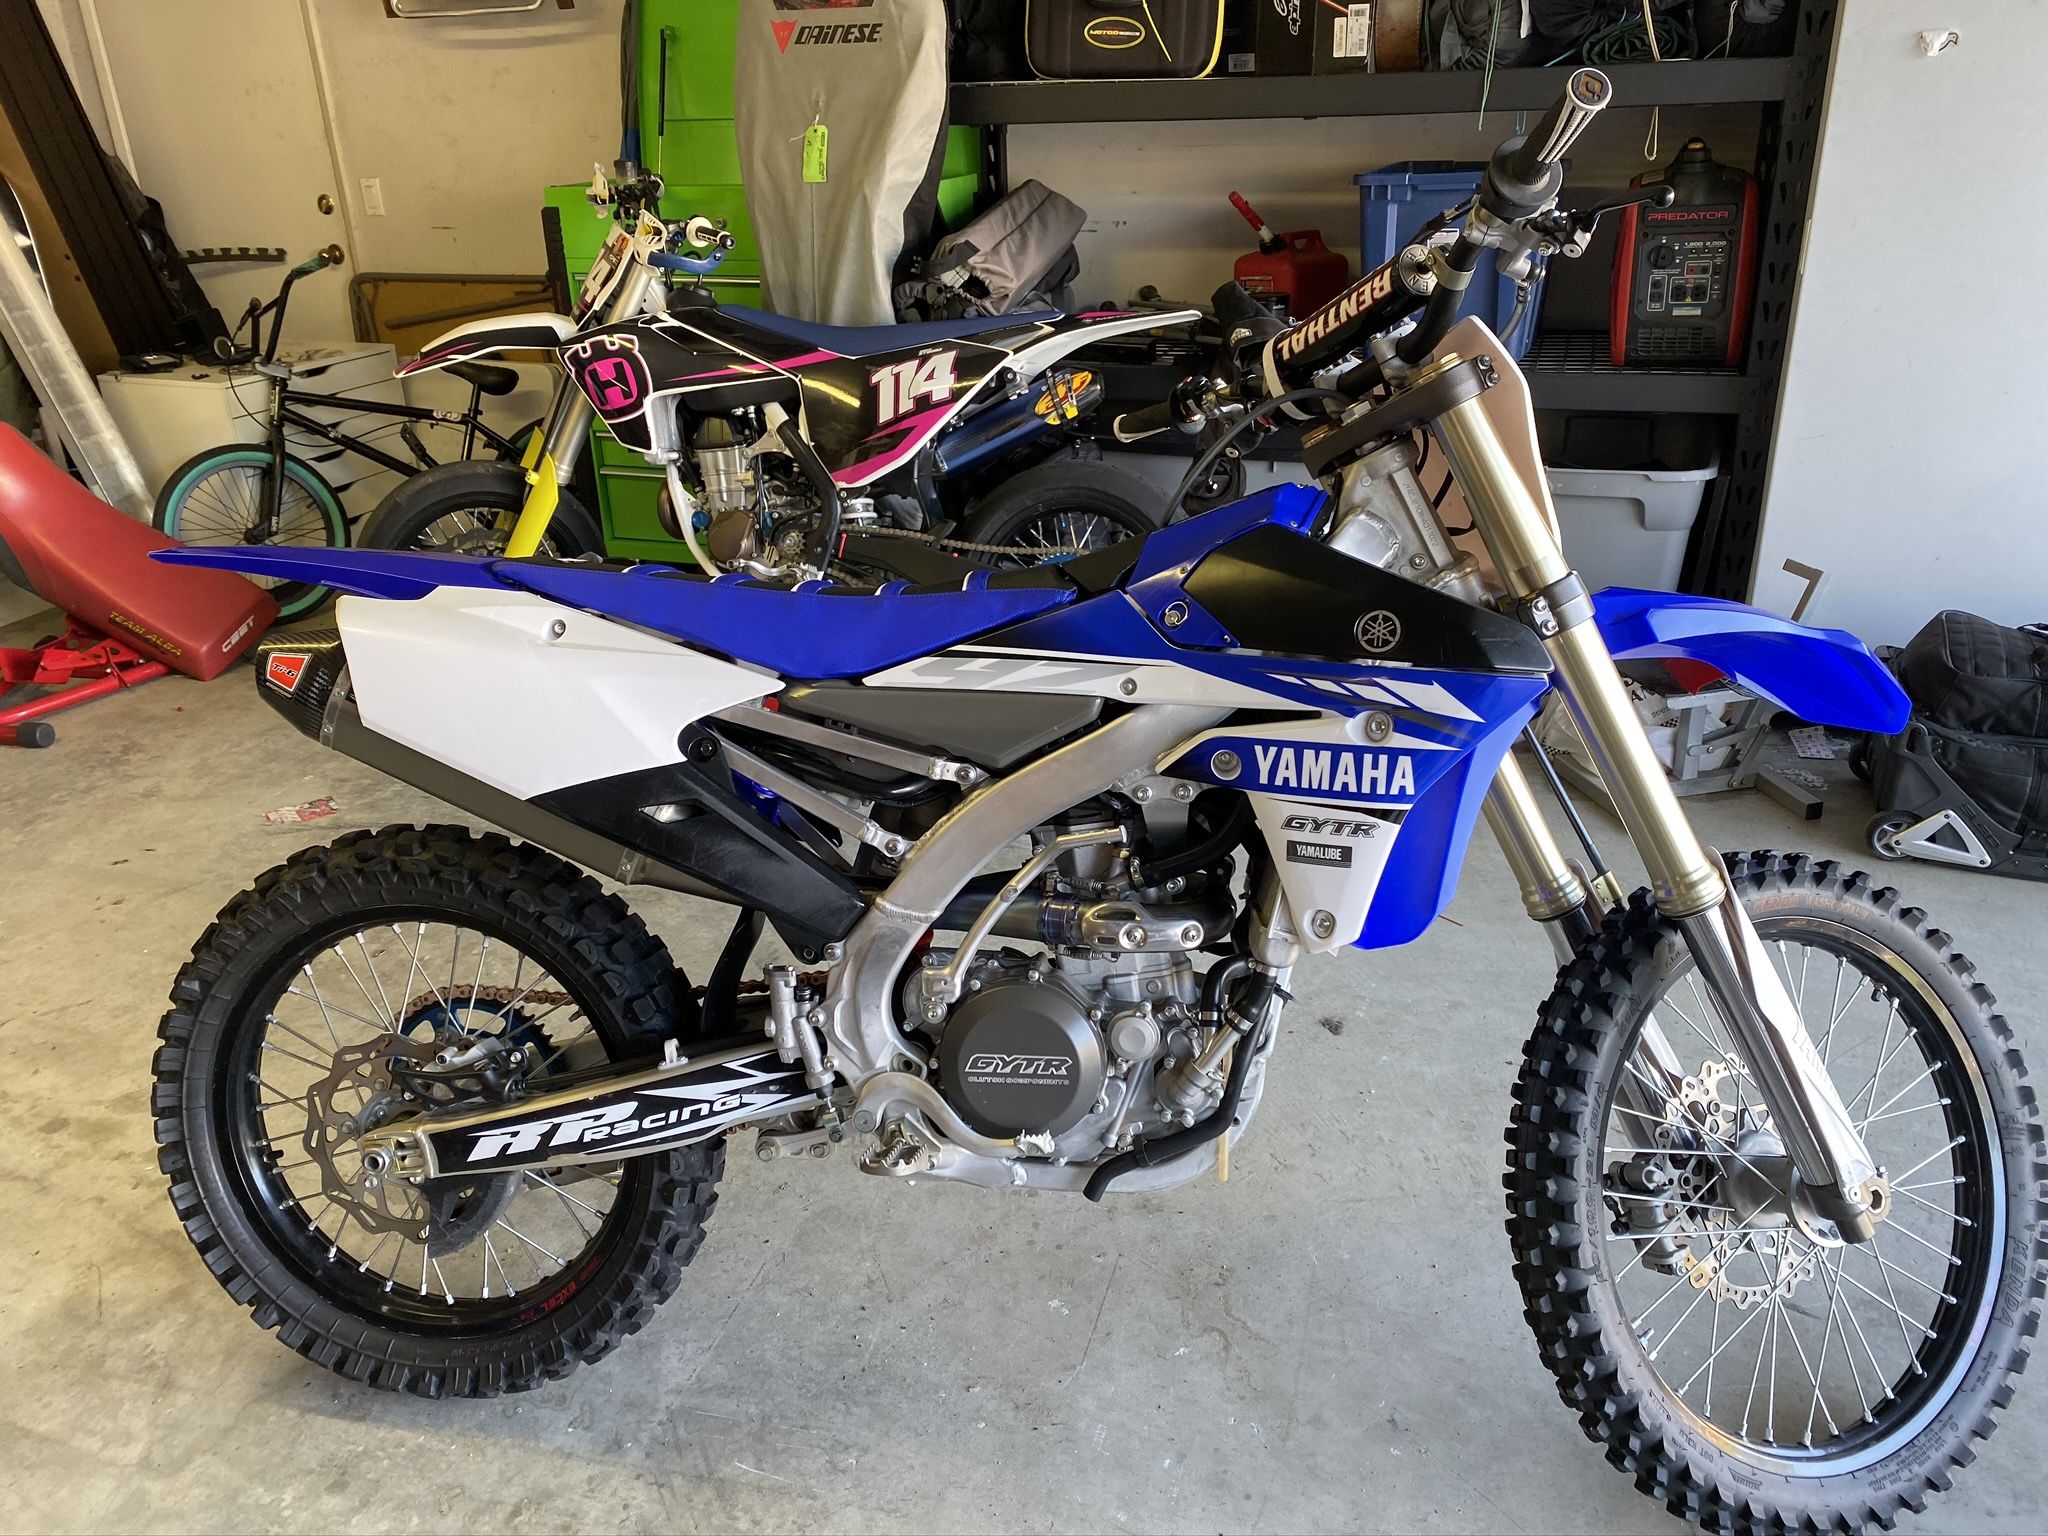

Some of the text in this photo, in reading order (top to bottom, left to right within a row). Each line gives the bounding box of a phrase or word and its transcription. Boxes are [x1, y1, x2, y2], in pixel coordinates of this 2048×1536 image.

[1647, 211, 1729, 221] PREDATOR
[1276, 267, 1393, 362] RENTHAL
[870, 350, 959, 426] 114
[1254, 744, 1416, 796] YAMAHA
[1281, 814, 1380, 839] GYTR
[1296, 844, 1343, 861] YAMALUBE
[964, 1053, 1073, 1076] GYTR
[967, 1076, 1070, 1085] CLUTCH COMPONENTS
[2000, 1239, 2029, 1329] KENDA
